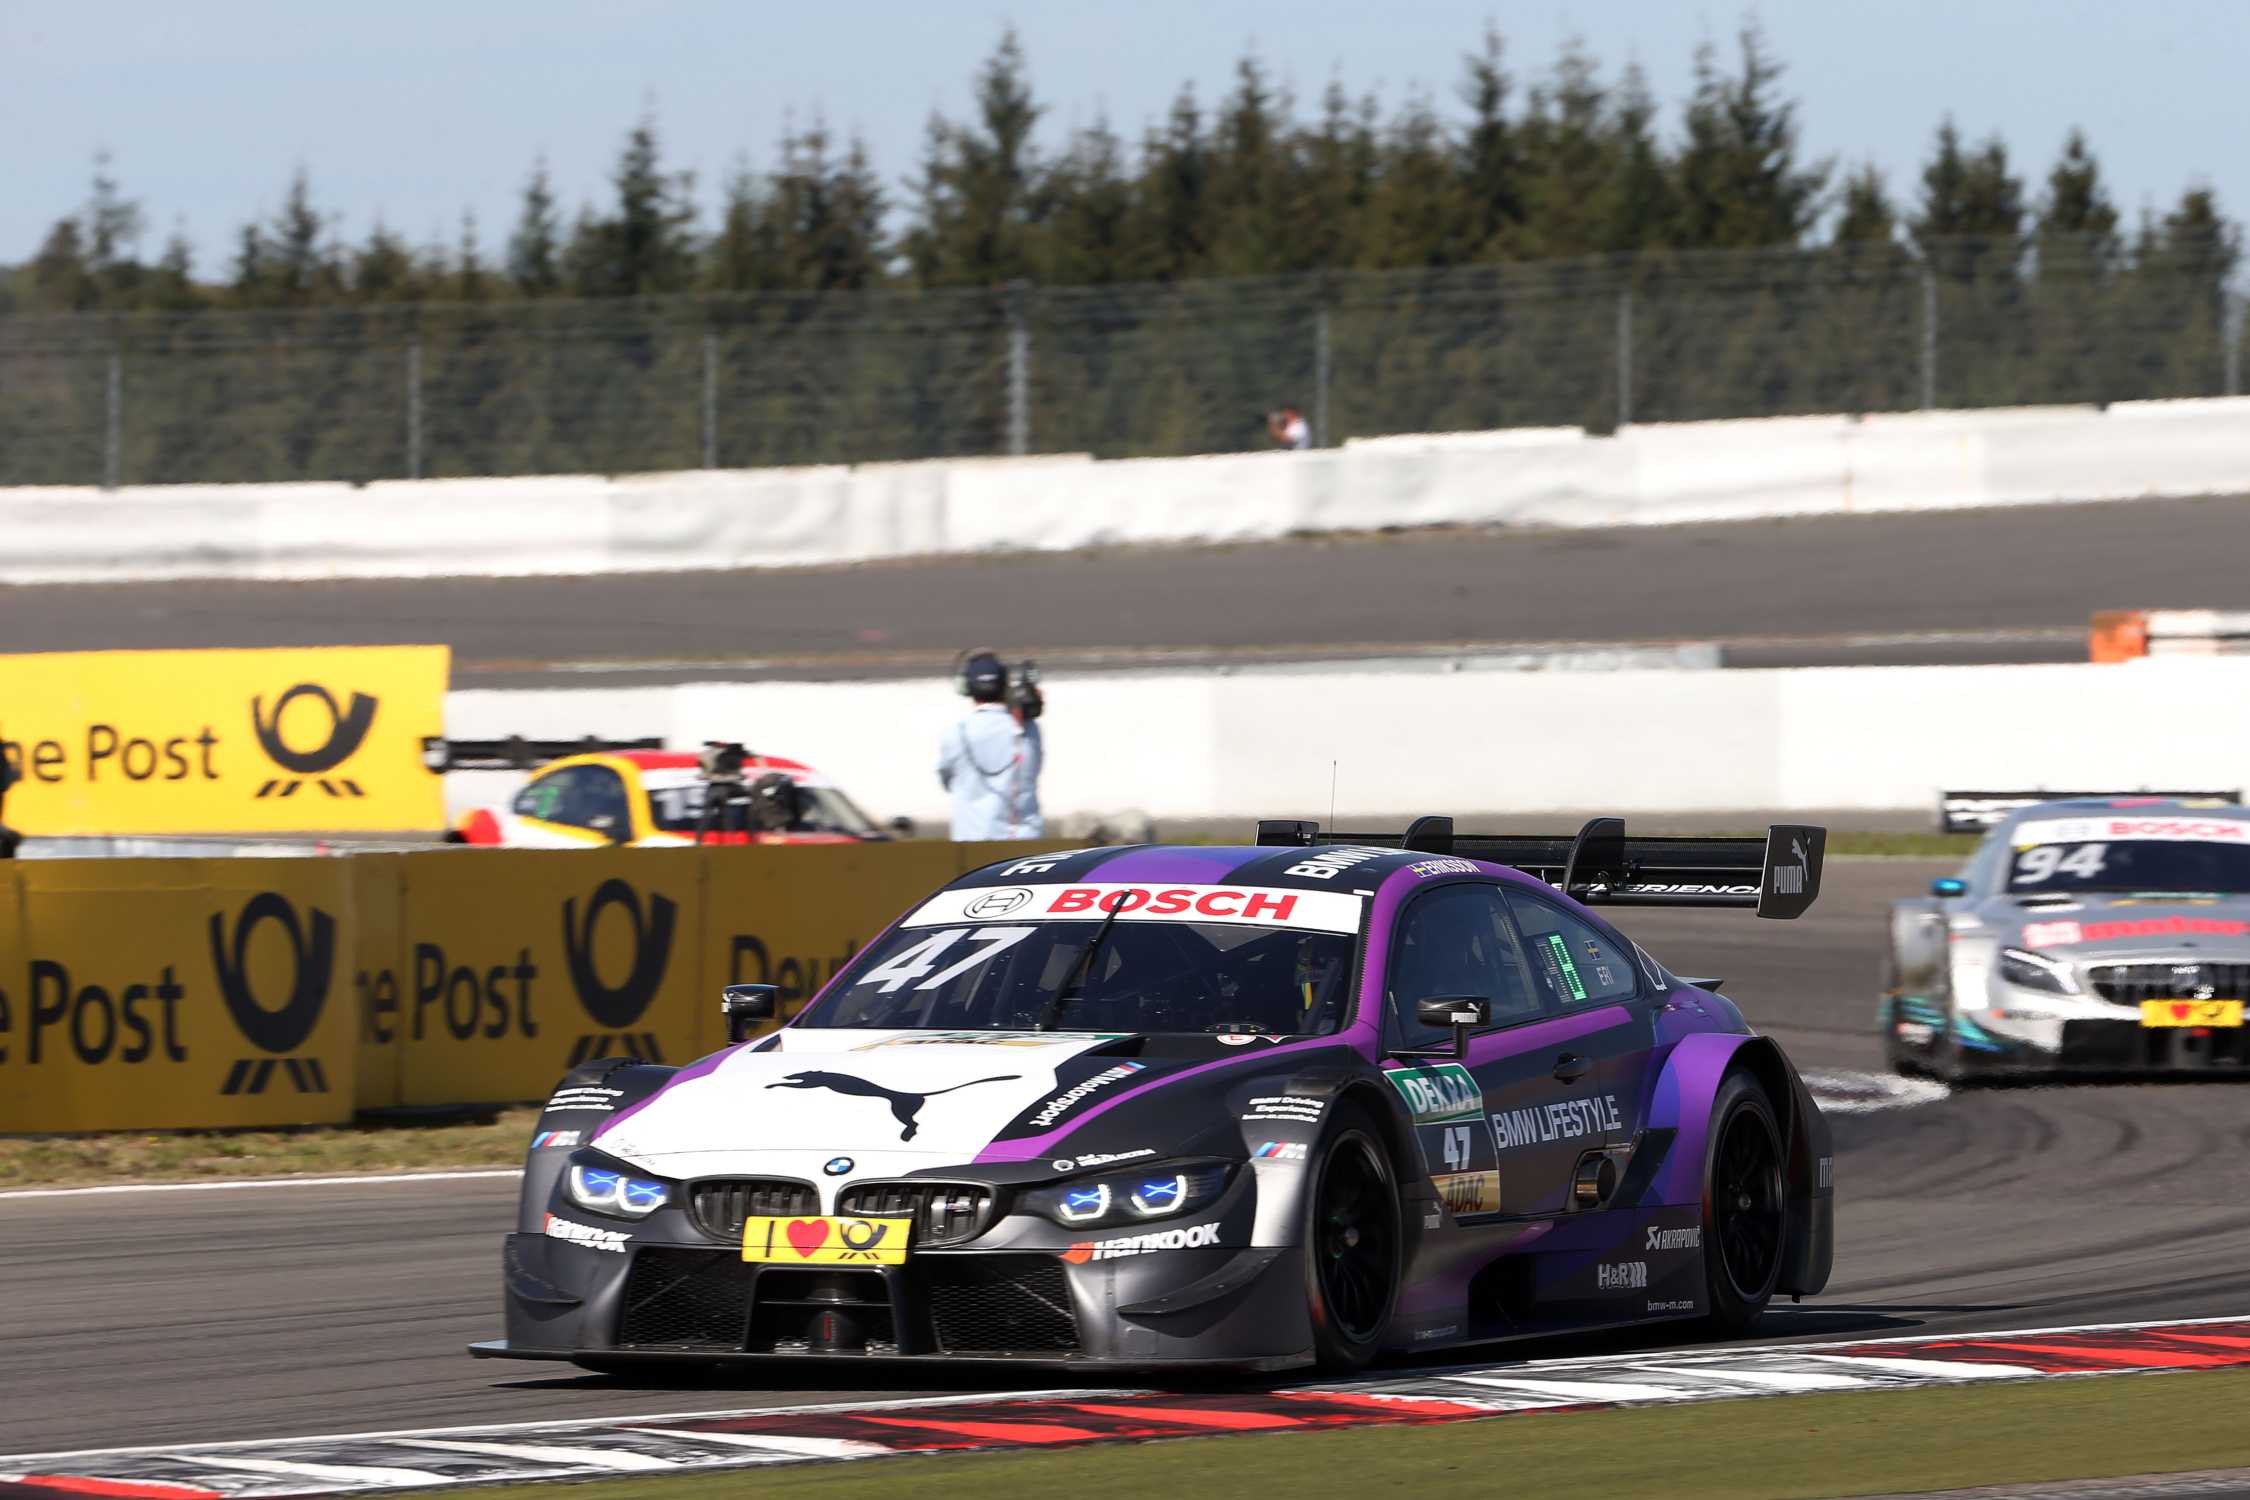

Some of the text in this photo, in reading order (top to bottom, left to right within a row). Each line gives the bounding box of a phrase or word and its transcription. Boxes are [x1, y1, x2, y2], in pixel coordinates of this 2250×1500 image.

[88, 724, 219, 781] Post
[2109, 822, 2241, 837] BOSCH
[1423, 858, 1480, 876] ERIKSSON
[1774, 865, 1802, 894] PUMA
[2013, 842, 2110, 884] 94
[1046, 887, 1298, 920] BOSCH
[855, 926, 1040, 994] 47
[412, 942, 540, 1040] Post
[28, 959, 188, 1066] Post
[1029, 1072, 1117, 1126] Motorsport
[1281, 1097, 1325, 1109] Driving
[1403, 1074, 1475, 1114] DEKRA
[1491, 1095, 1622, 1149] BMW LIFESTYLE
[1443, 1126, 1471, 1171] 47
[1446, 1174, 1486, 1213] ADAC
[1598, 1263, 1630, 1289] H&R
[1647, 1300, 1694, 1311] bmw-m.com
